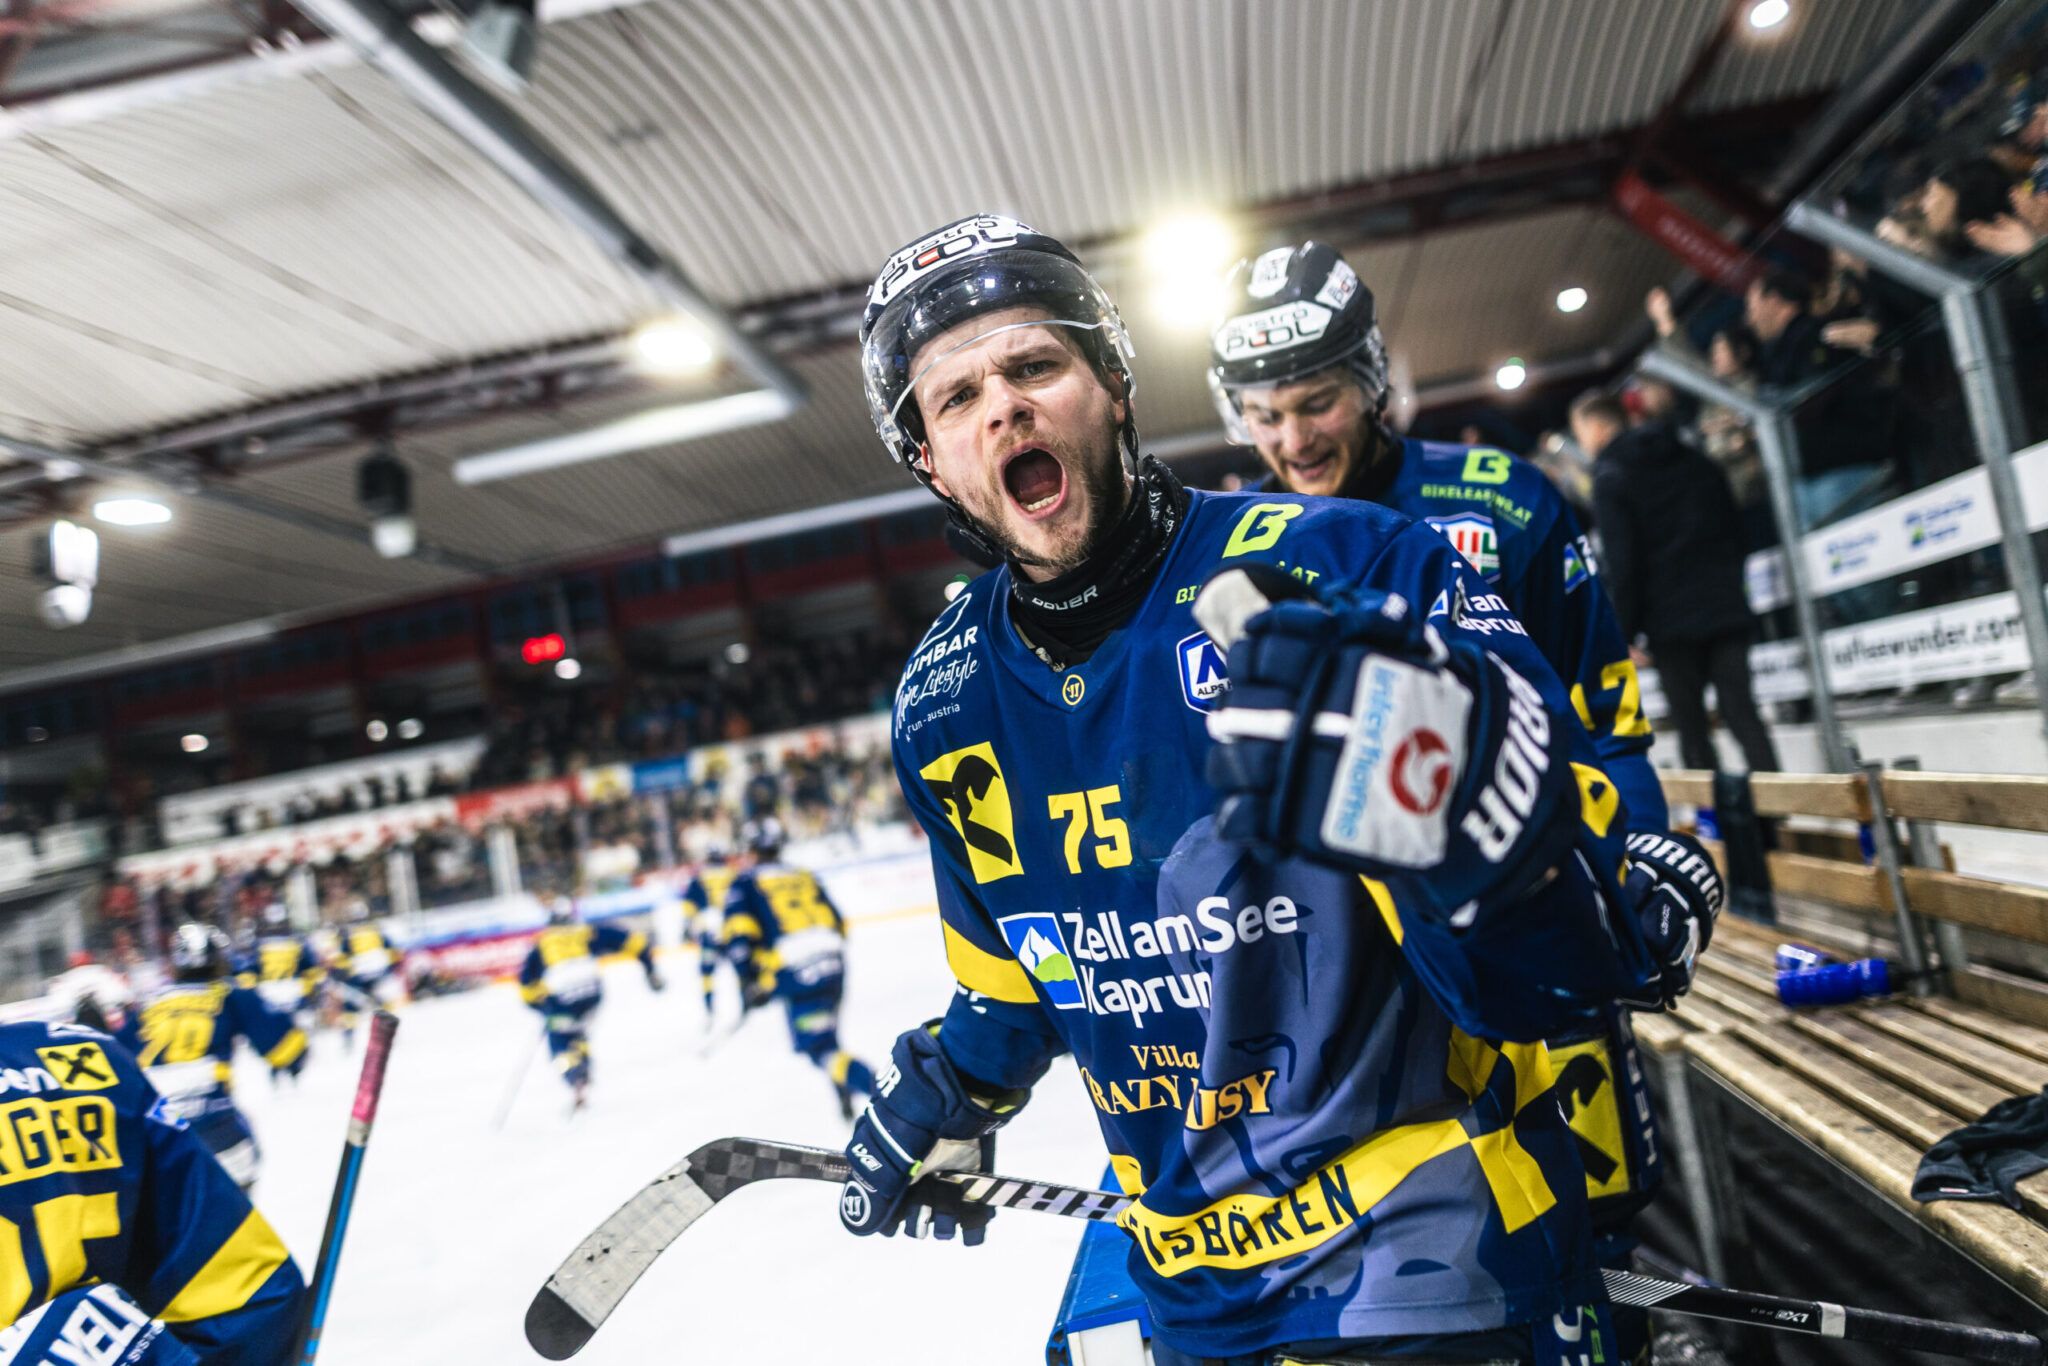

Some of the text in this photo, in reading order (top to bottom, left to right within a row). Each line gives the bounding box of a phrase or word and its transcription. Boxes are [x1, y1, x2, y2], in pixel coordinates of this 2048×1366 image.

[918, 652, 978, 702] Lifestyle
[1048, 784, 1133, 875] 75
[1062, 895, 1299, 963] Zell am See
[1079, 965, 1212, 1029] Kaprun
[1130, 1044, 1200, 1071] Villa
